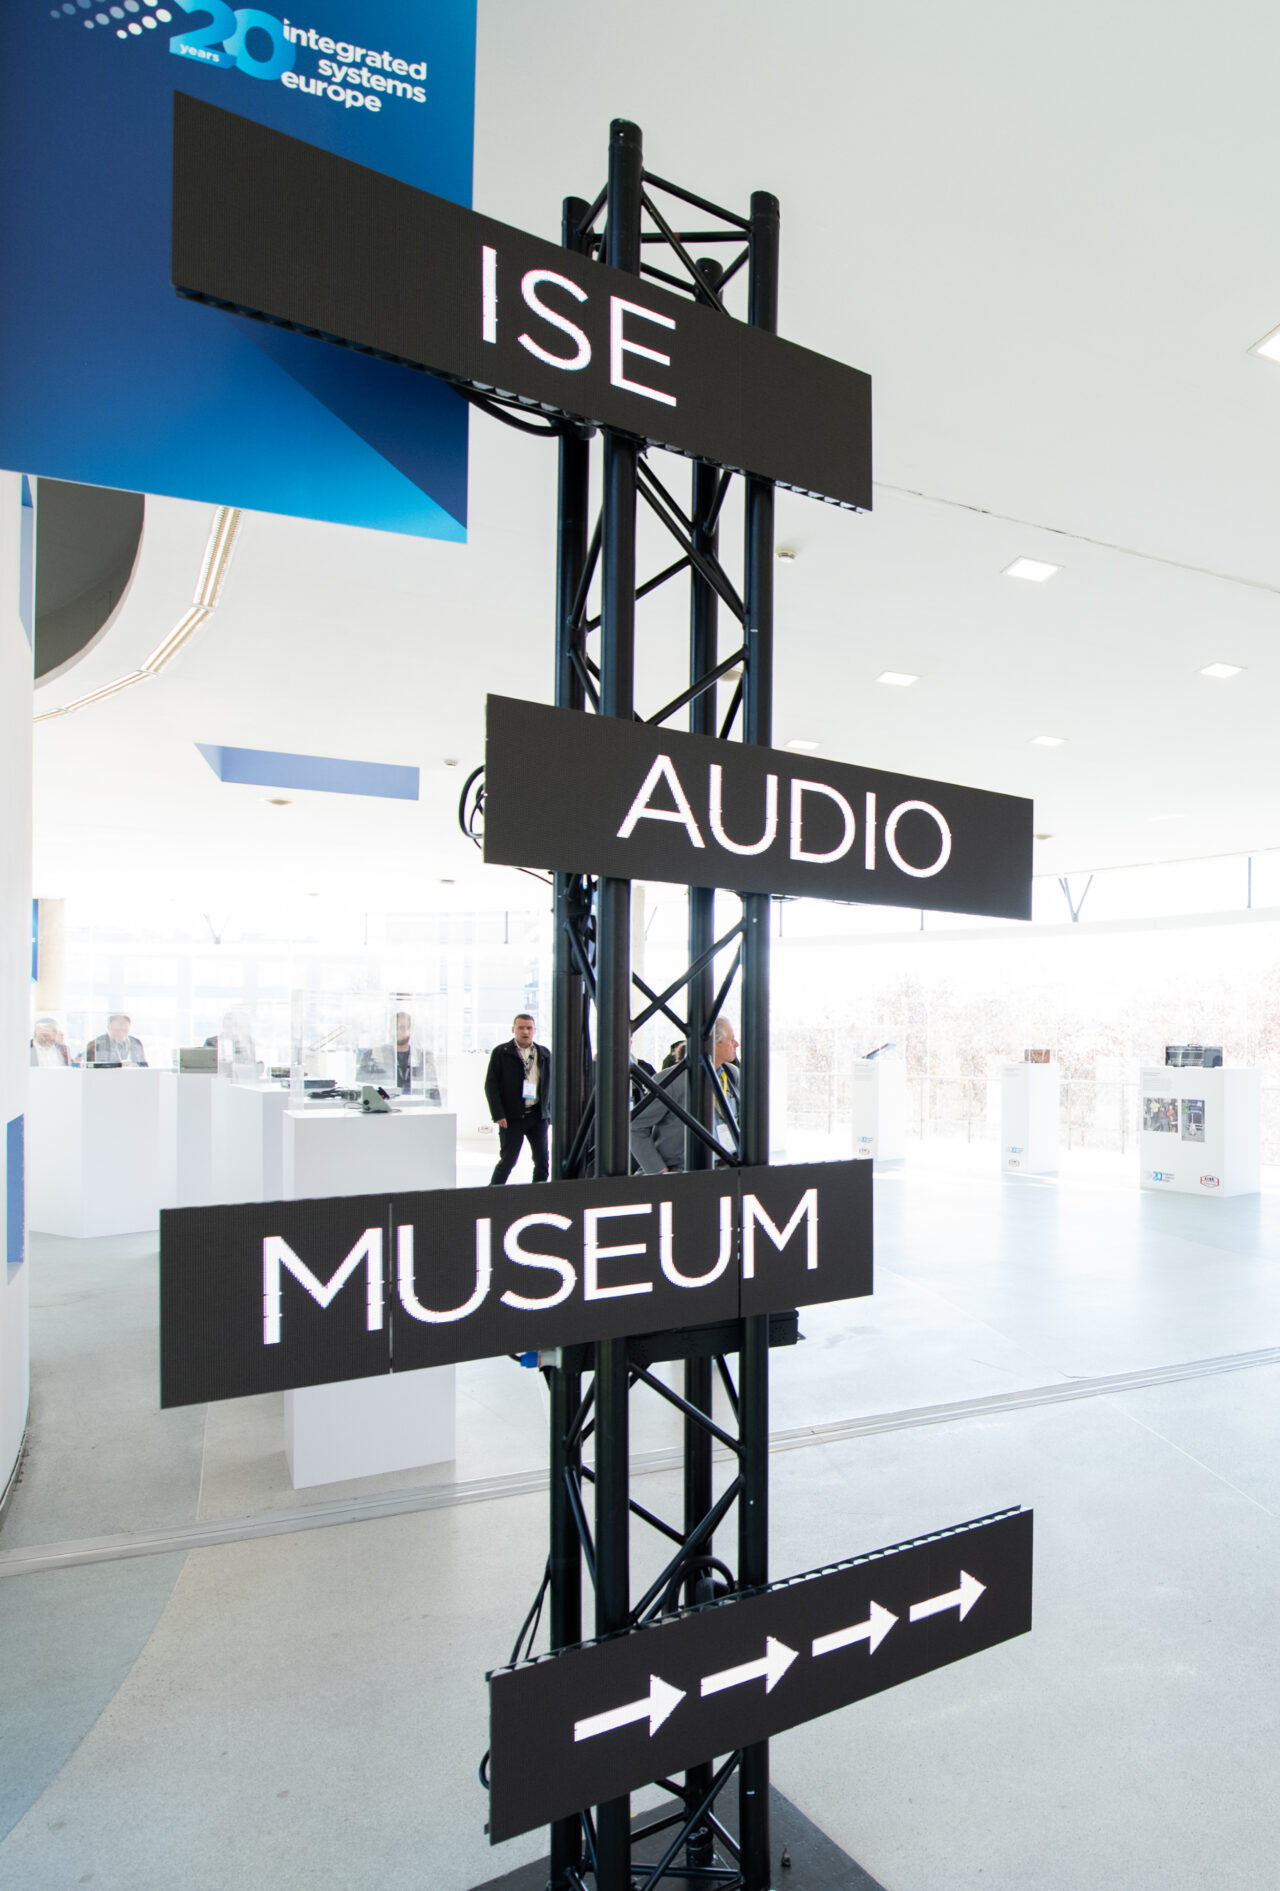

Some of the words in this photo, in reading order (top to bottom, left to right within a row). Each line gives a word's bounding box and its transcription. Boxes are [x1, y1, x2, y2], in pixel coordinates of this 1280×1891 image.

[169, 0, 297, 81] 20
[179, 43, 221, 64] years
[283, 18, 428, 81] integrated
[281, 71, 382, 112] europe
[317, 59, 427, 103] systems
[482, 245, 679, 408] ISE
[616, 754, 954, 879] AUDIO
[262, 1187, 820, 1346] MUSEUM
